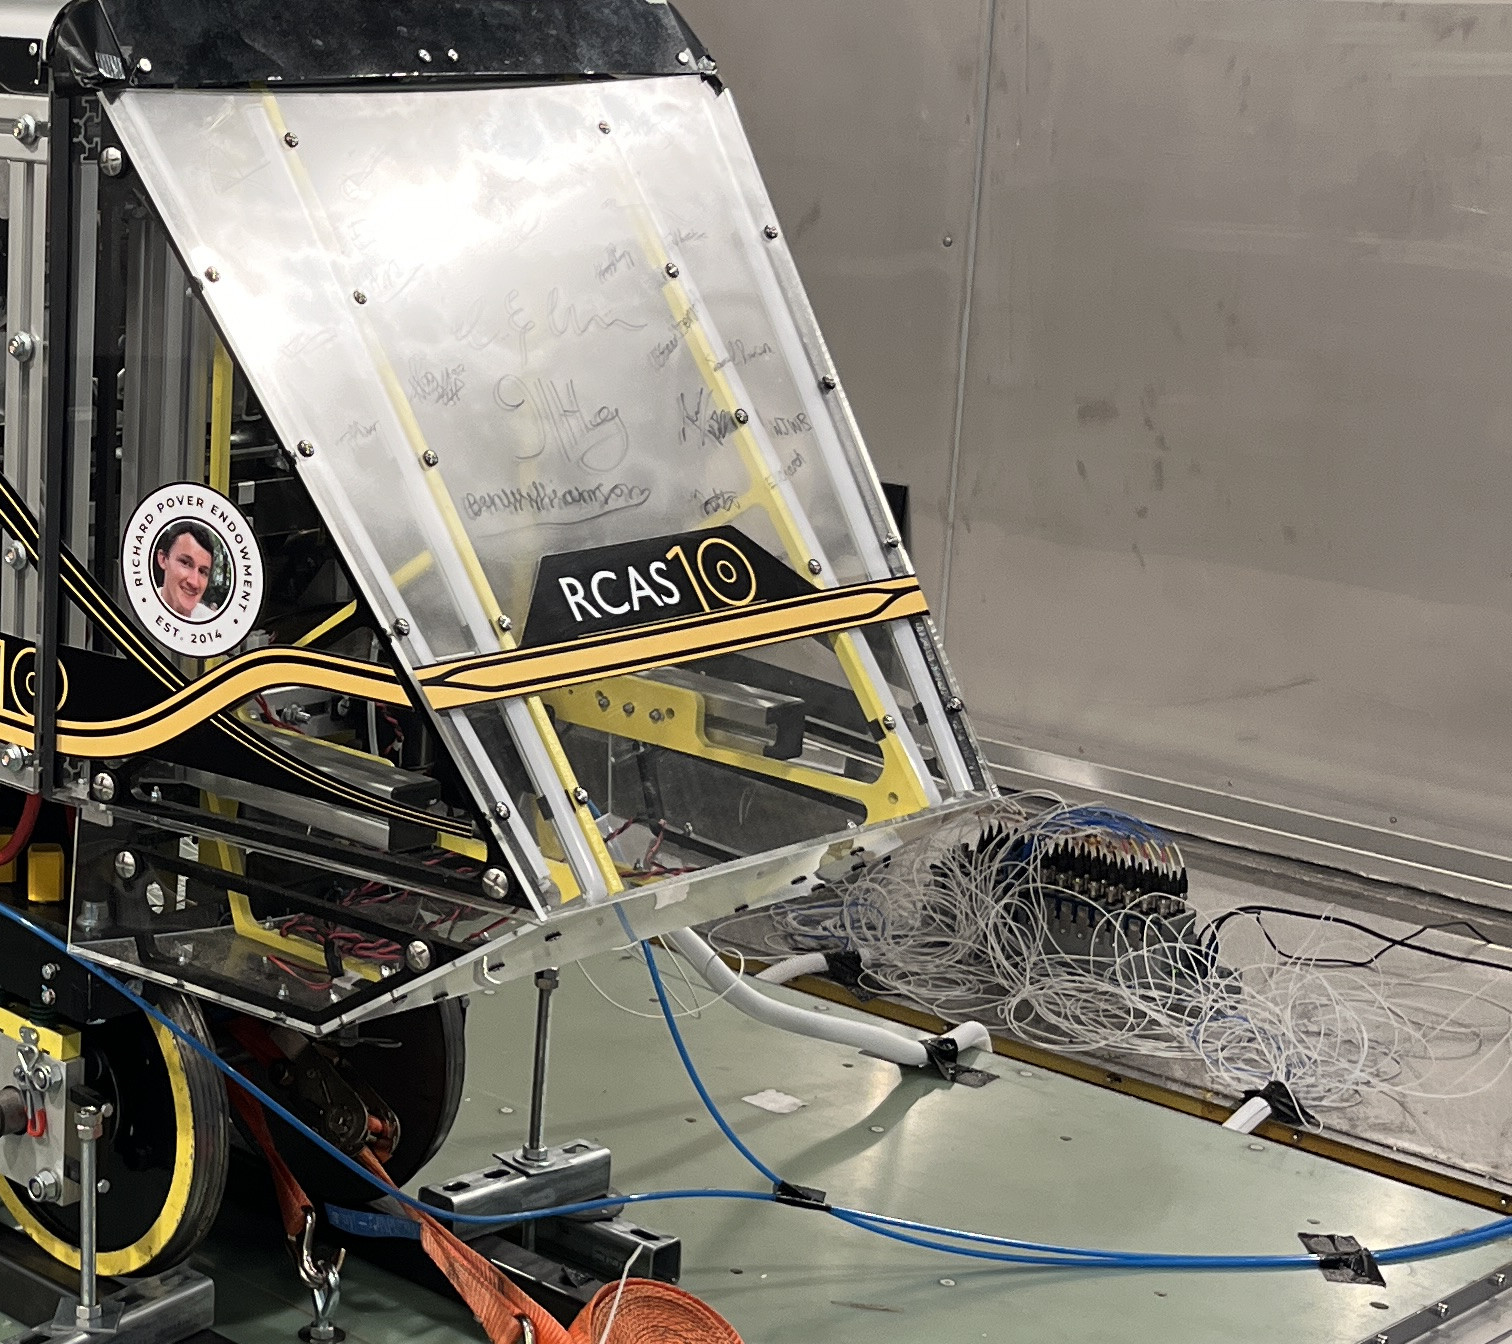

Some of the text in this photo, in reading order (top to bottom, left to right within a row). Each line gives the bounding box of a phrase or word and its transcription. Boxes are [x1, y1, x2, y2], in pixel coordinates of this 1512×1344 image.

[132, 495, 253, 613] RICHARD POVER ENDOWMENT
[190, 629, 222, 643] 2014
